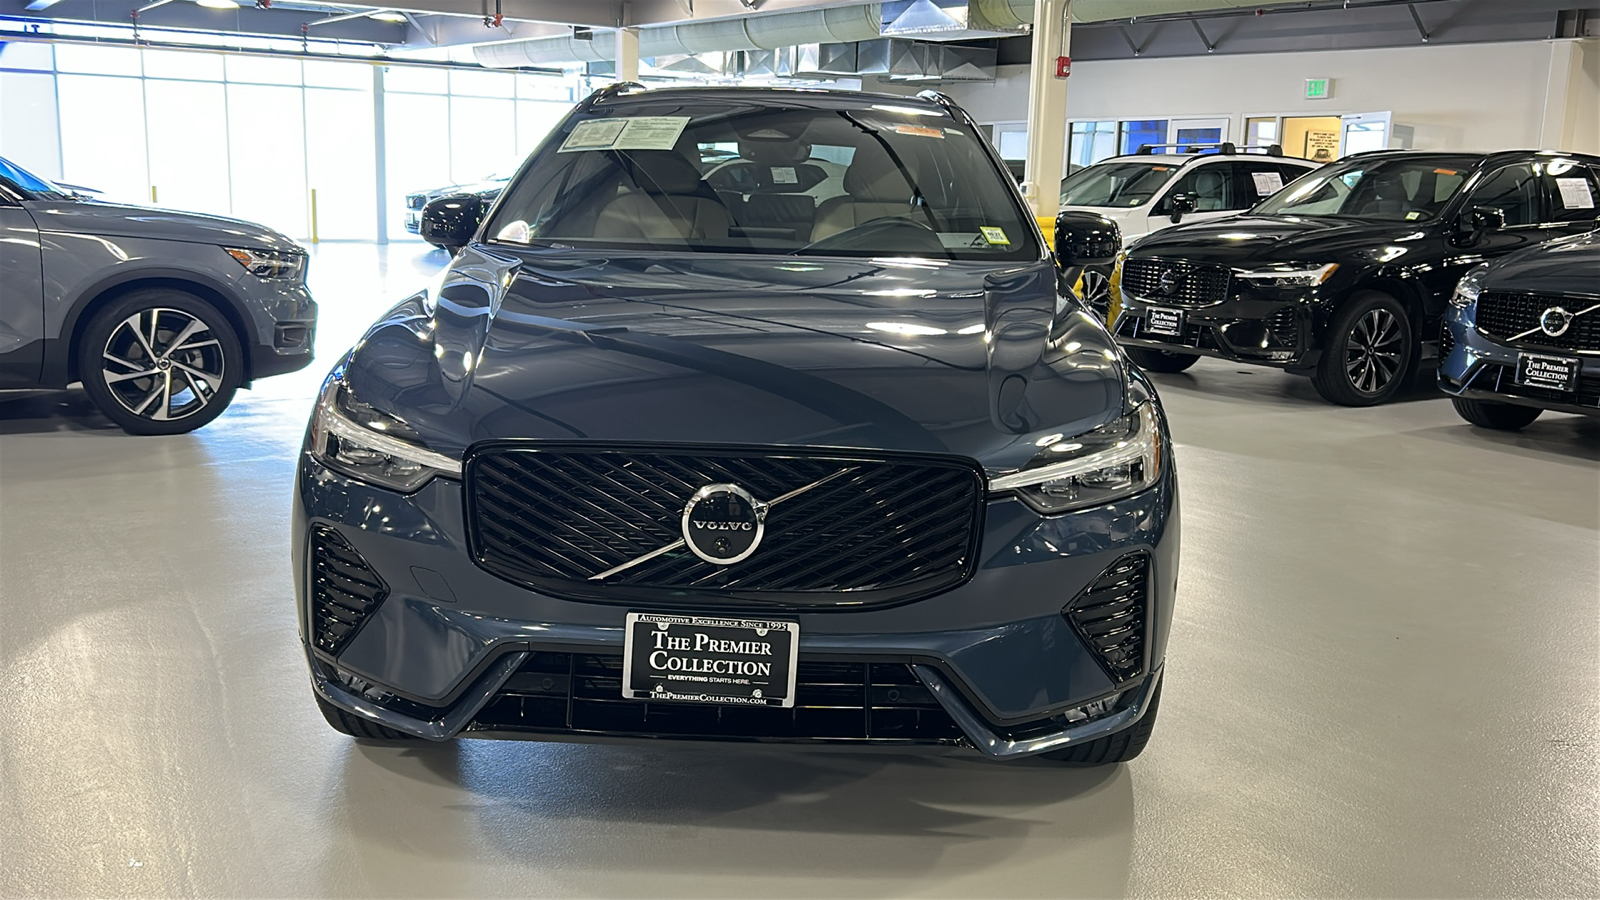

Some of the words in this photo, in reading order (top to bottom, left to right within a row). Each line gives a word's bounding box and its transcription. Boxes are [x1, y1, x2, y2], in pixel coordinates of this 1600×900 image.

[1527, 360, 1541, 369] THE
[1541, 361, 1568, 373] PREMIER
[1525, 367, 1568, 380] COLLECTION
[693, 520, 753, 531] VOLVO
[766, 622, 787, 630] 1995
[651, 630, 691, 650] THE
[693, 633, 772, 655] PREMIER
[649, 650, 772, 676] COLLECTION
[667, 674, 708, 682] EVERYTHING
[708, 676, 732, 684] STARTS
